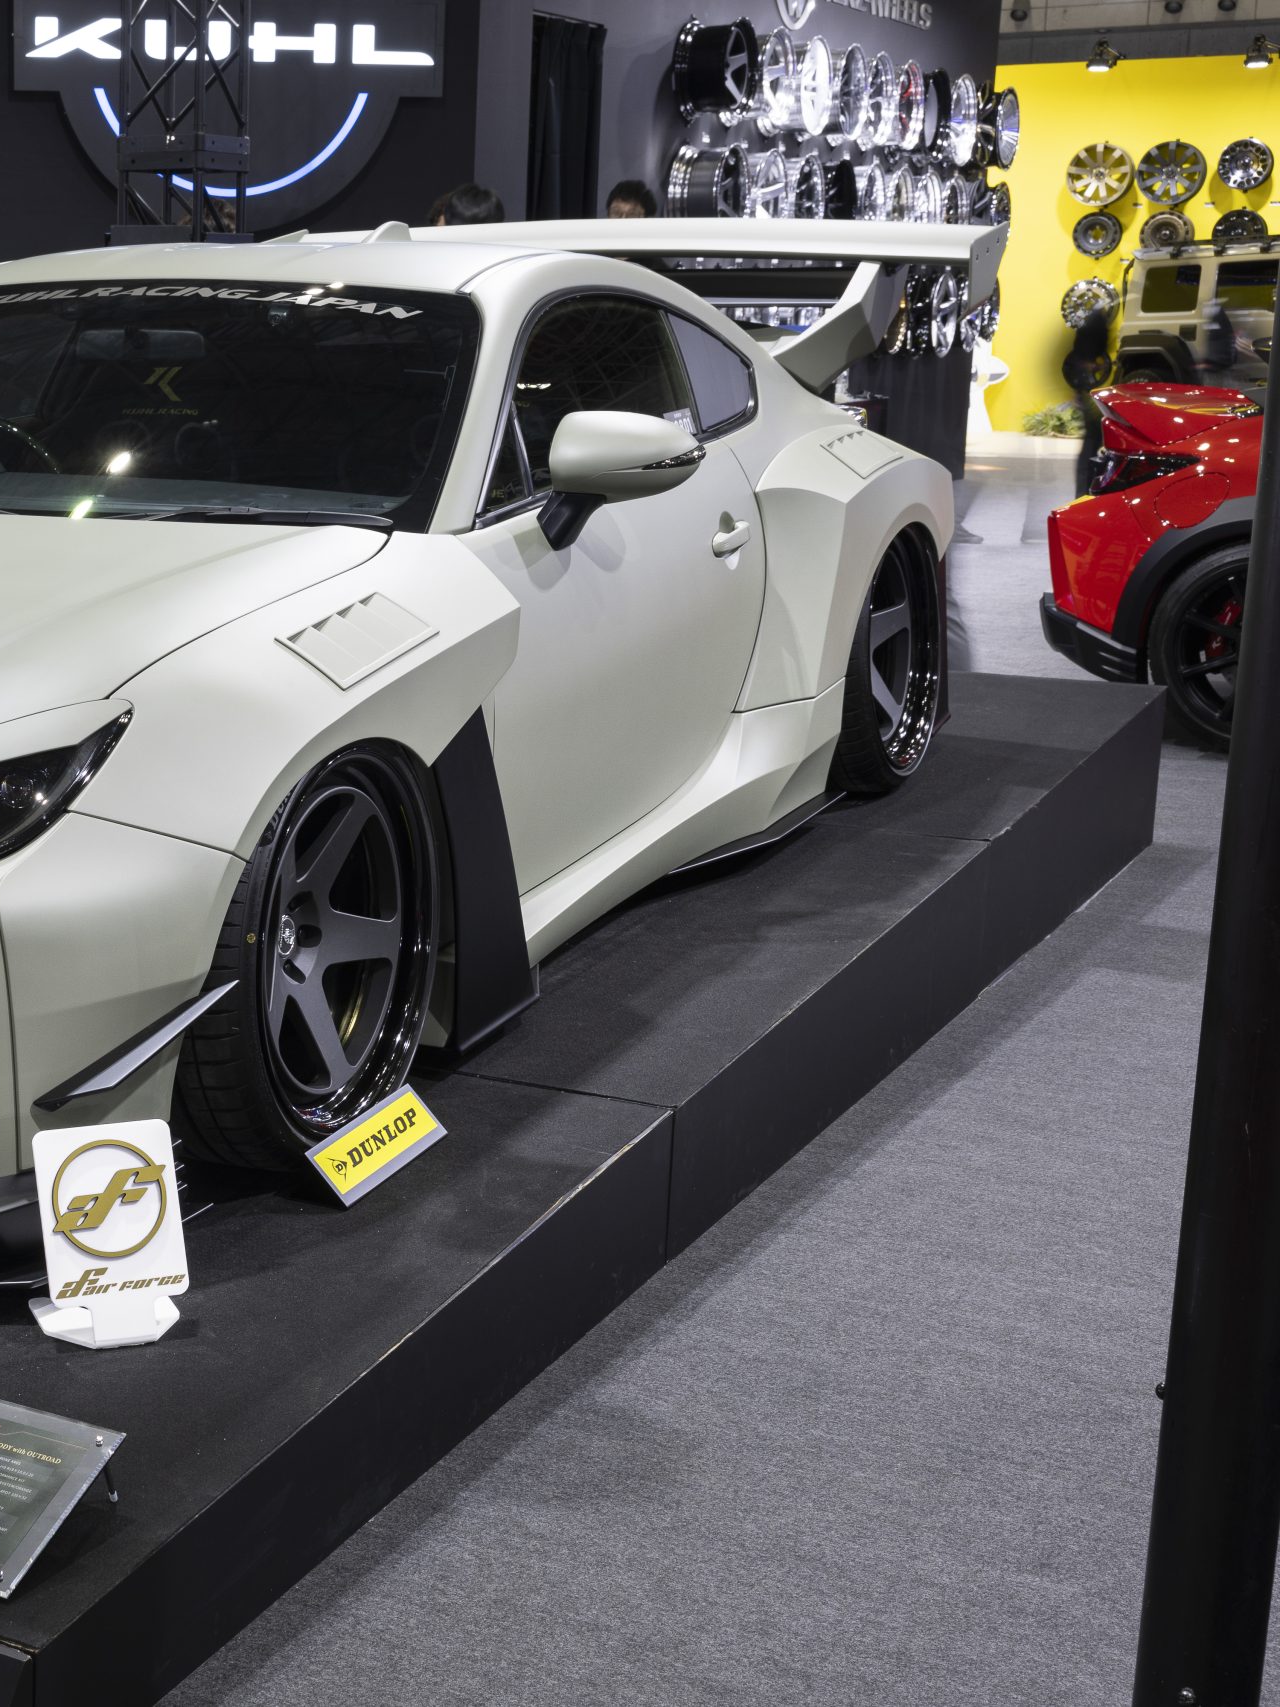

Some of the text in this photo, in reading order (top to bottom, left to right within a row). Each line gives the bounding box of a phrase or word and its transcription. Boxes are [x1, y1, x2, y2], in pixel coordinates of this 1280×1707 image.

[25, 16, 435, 66] KUHL
[241, 290, 423, 319] JAPAN
[346, 1108, 417, 1168] DUNLOP
[26, 1451, 61, 1464] OUTROAD
